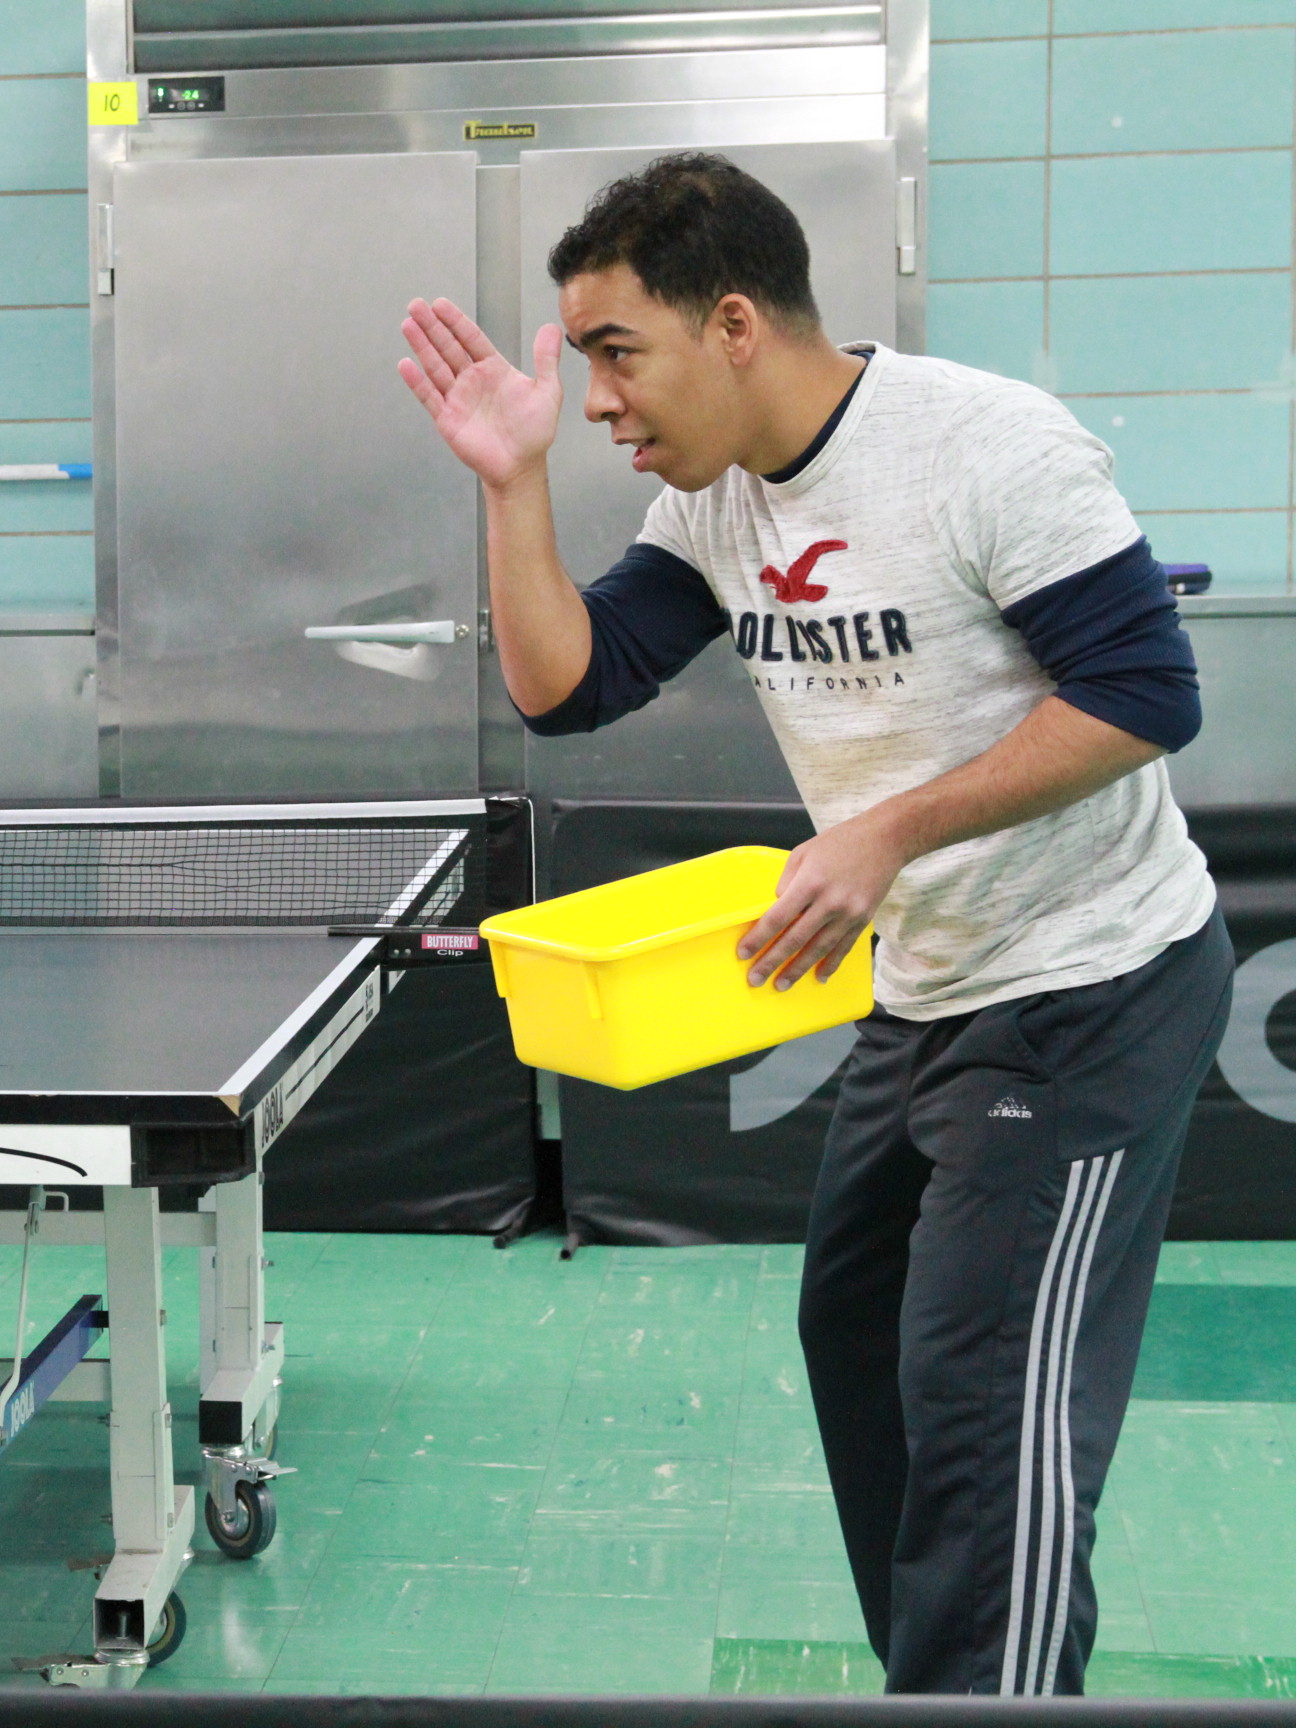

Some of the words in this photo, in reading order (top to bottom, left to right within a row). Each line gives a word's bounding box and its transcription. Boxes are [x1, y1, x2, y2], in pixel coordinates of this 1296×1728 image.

[104, 93, 121, 112] 10
[736, 608, 912, 664] OLLISTER
[754, 672, 905, 691] ALIFORNIA
[427, 935, 473, 948] BUTTERFLY
[436, 949, 464, 957] Clip
[10, 1381, 35, 1437] JOOLA
